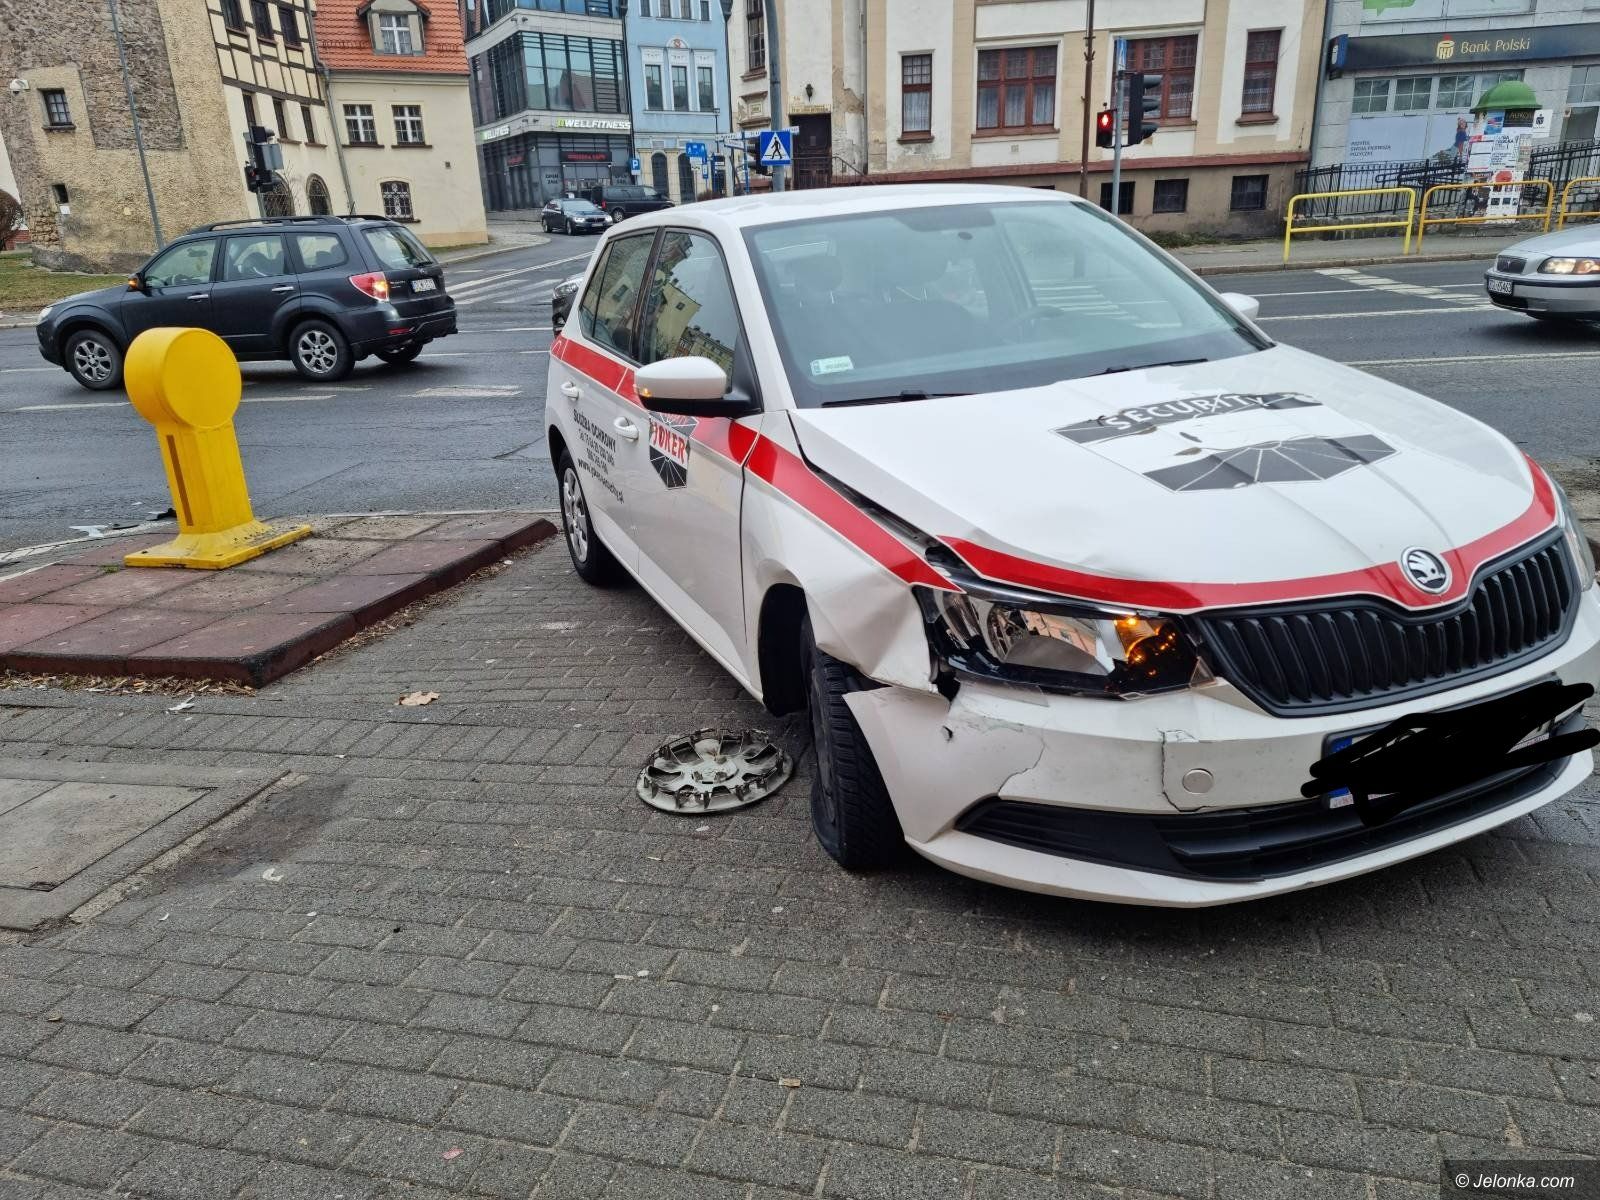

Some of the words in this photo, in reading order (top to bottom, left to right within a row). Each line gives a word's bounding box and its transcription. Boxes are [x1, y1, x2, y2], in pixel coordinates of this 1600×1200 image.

[1461, 41, 1490, 54] Bank
[1496, 38, 1530, 51] Polski
[565, 119, 632, 130] WELLFITNESS
[1105, 394, 1269, 430] SECURITY
